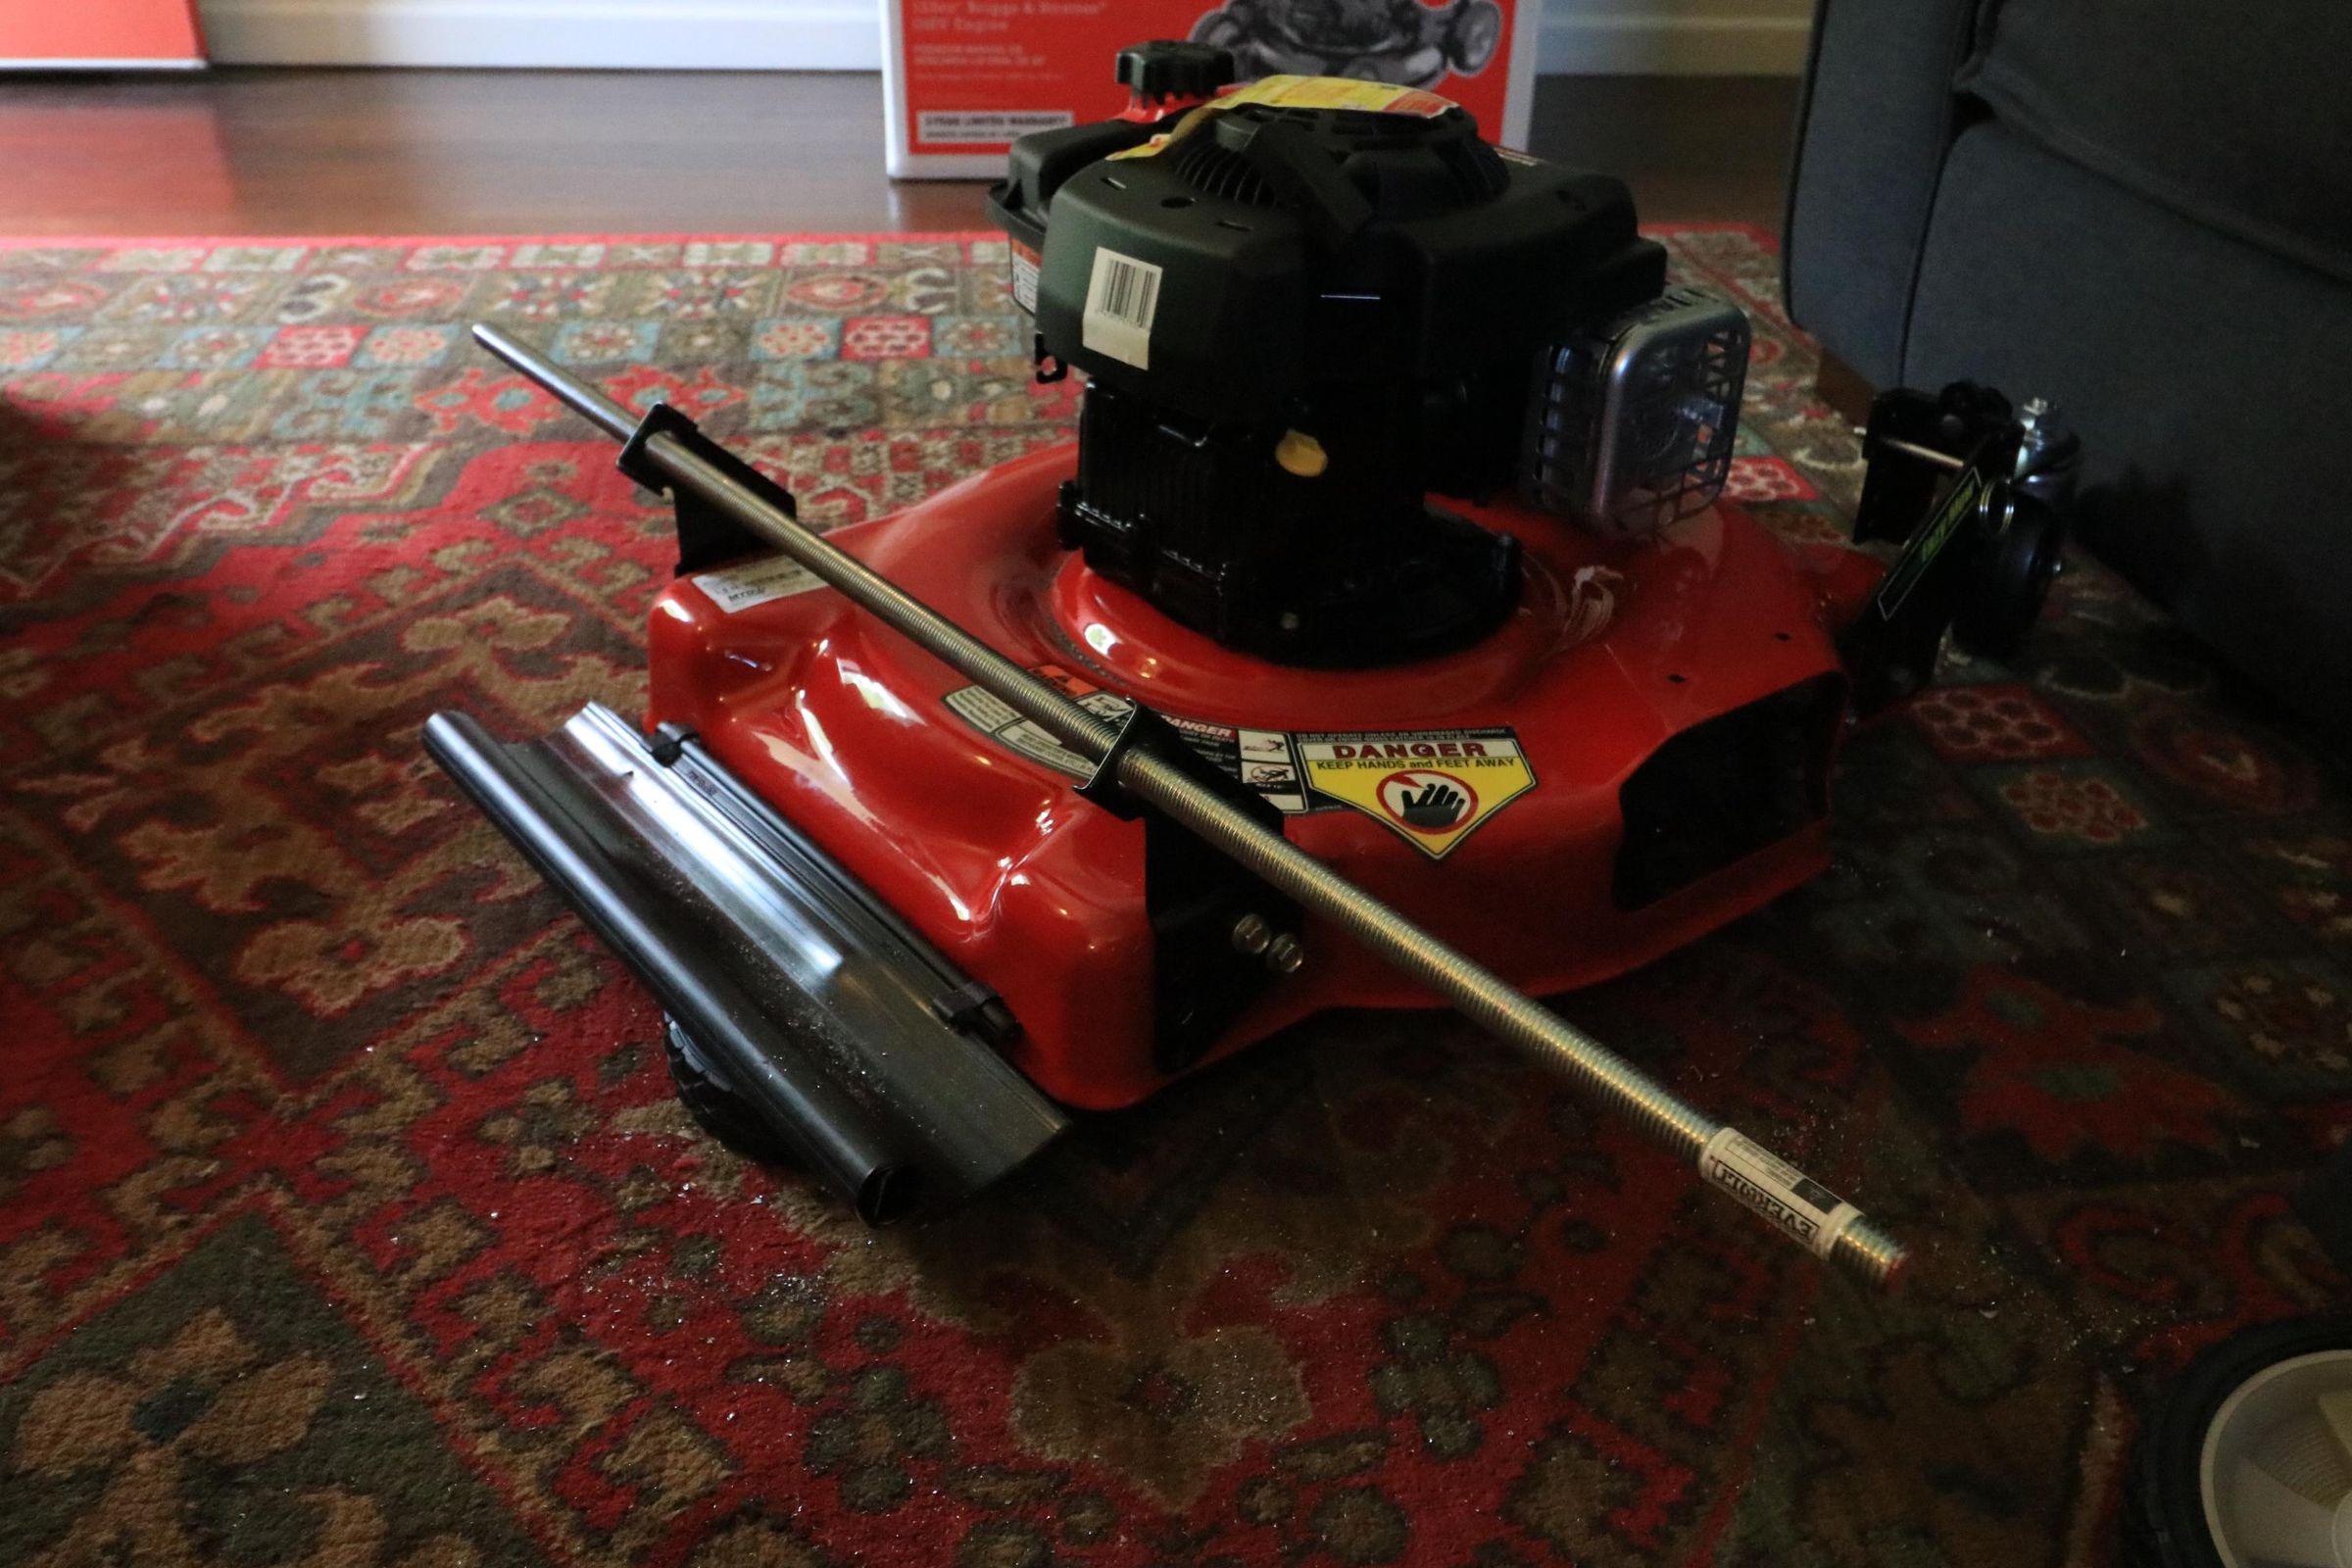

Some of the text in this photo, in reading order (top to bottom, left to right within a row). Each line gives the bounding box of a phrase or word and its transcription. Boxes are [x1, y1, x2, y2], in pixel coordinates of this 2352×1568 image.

[1332, 742, 1489, 760] DANGER
[1317, 758, 1515, 770] KEEP HANDS and FEET AWAY
